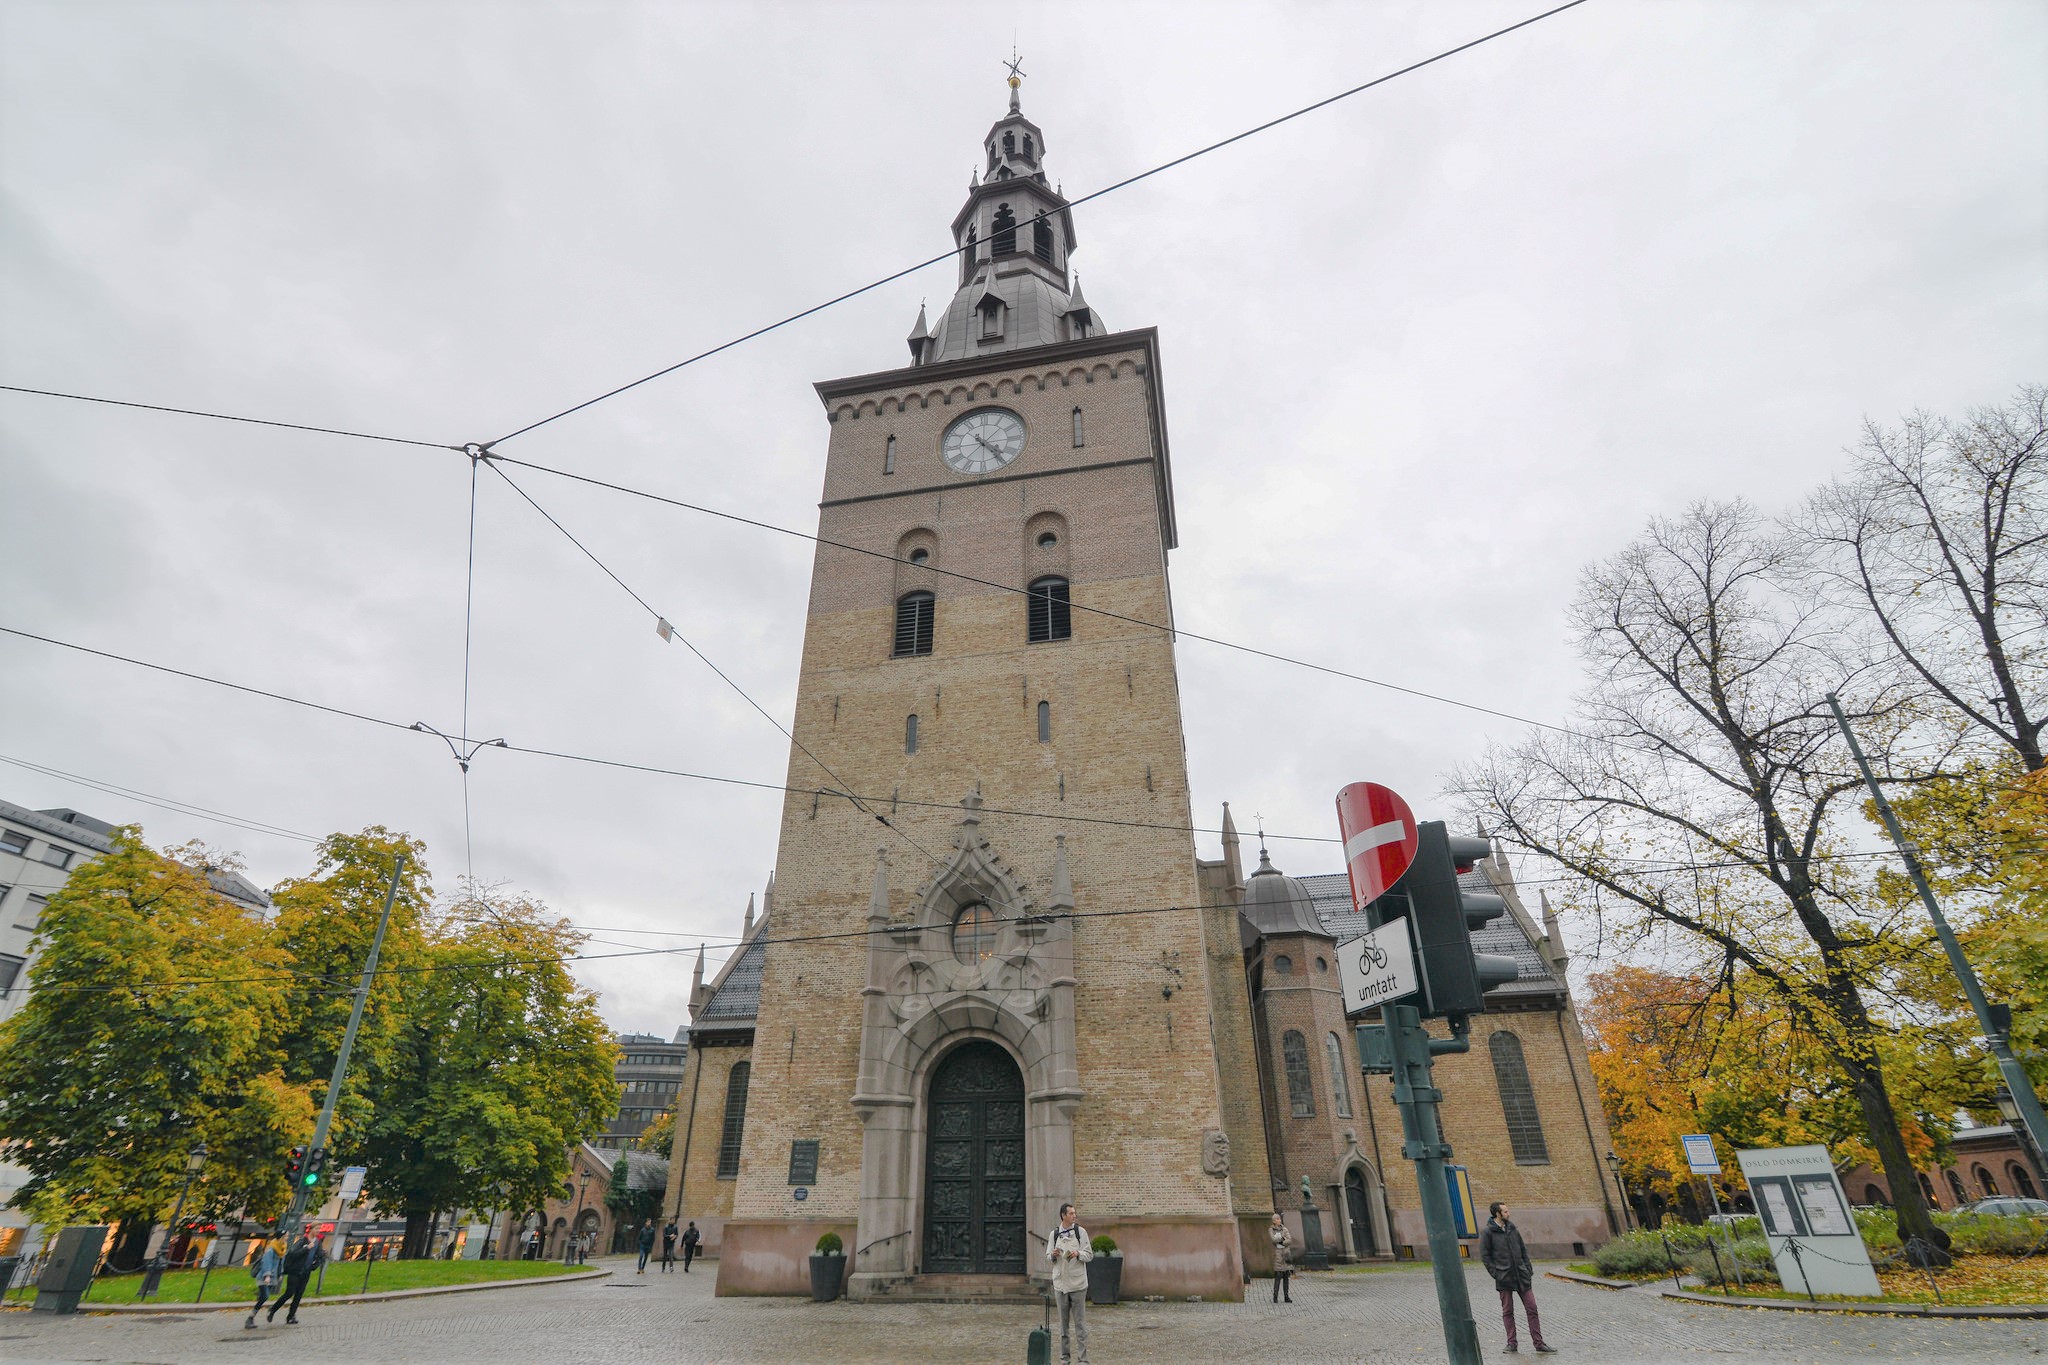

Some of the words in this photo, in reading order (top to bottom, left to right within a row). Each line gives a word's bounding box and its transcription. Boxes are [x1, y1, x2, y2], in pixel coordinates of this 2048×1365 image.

[1358, 973, 1398, 1001] unntatt
[1745, 1159, 1770, 1168] OSLO
[1771, 1156, 1825, 1167] DOMKIRKE
